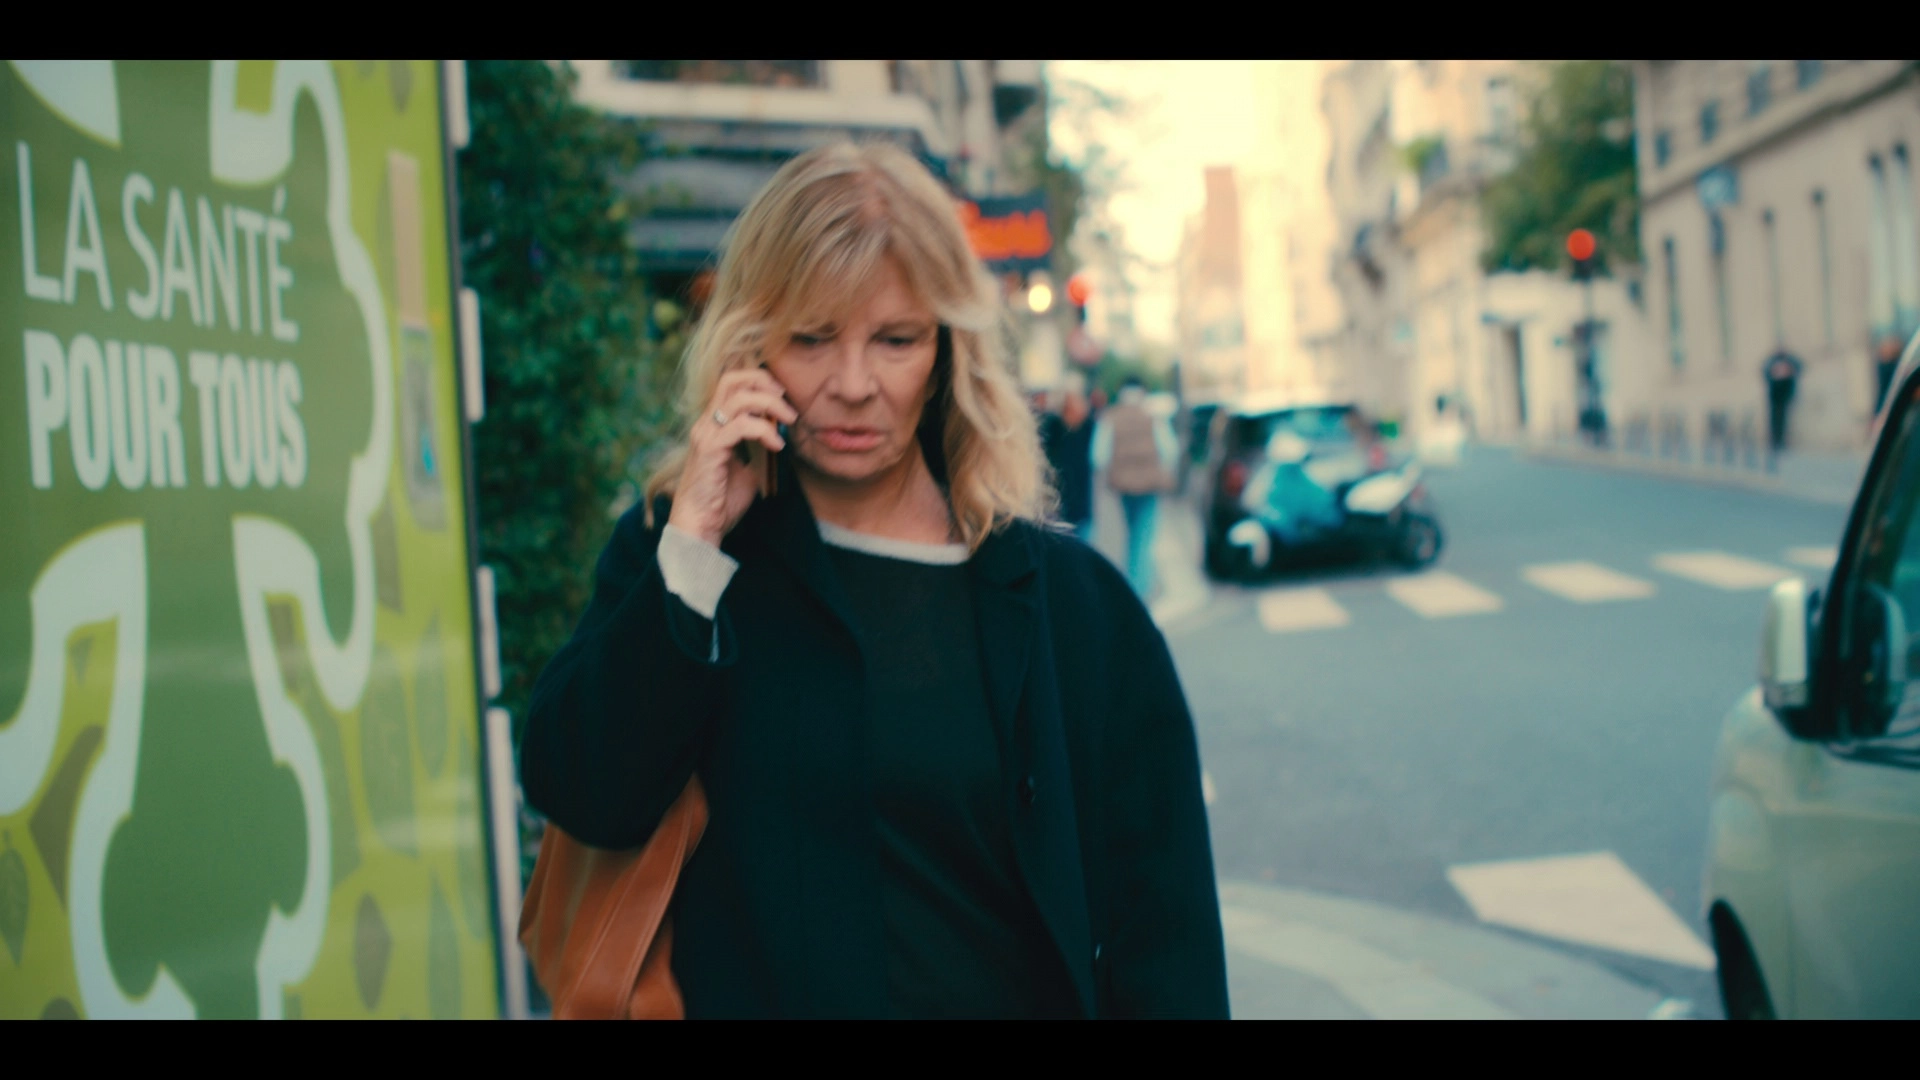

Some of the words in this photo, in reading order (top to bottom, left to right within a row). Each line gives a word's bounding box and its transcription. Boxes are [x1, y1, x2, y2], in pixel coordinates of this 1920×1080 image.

[16, 141, 113, 311] LA
[122, 172, 299, 342] SANTÉ
[23, 329, 188, 490] POUR
[189, 350, 308, 490] TOUS
